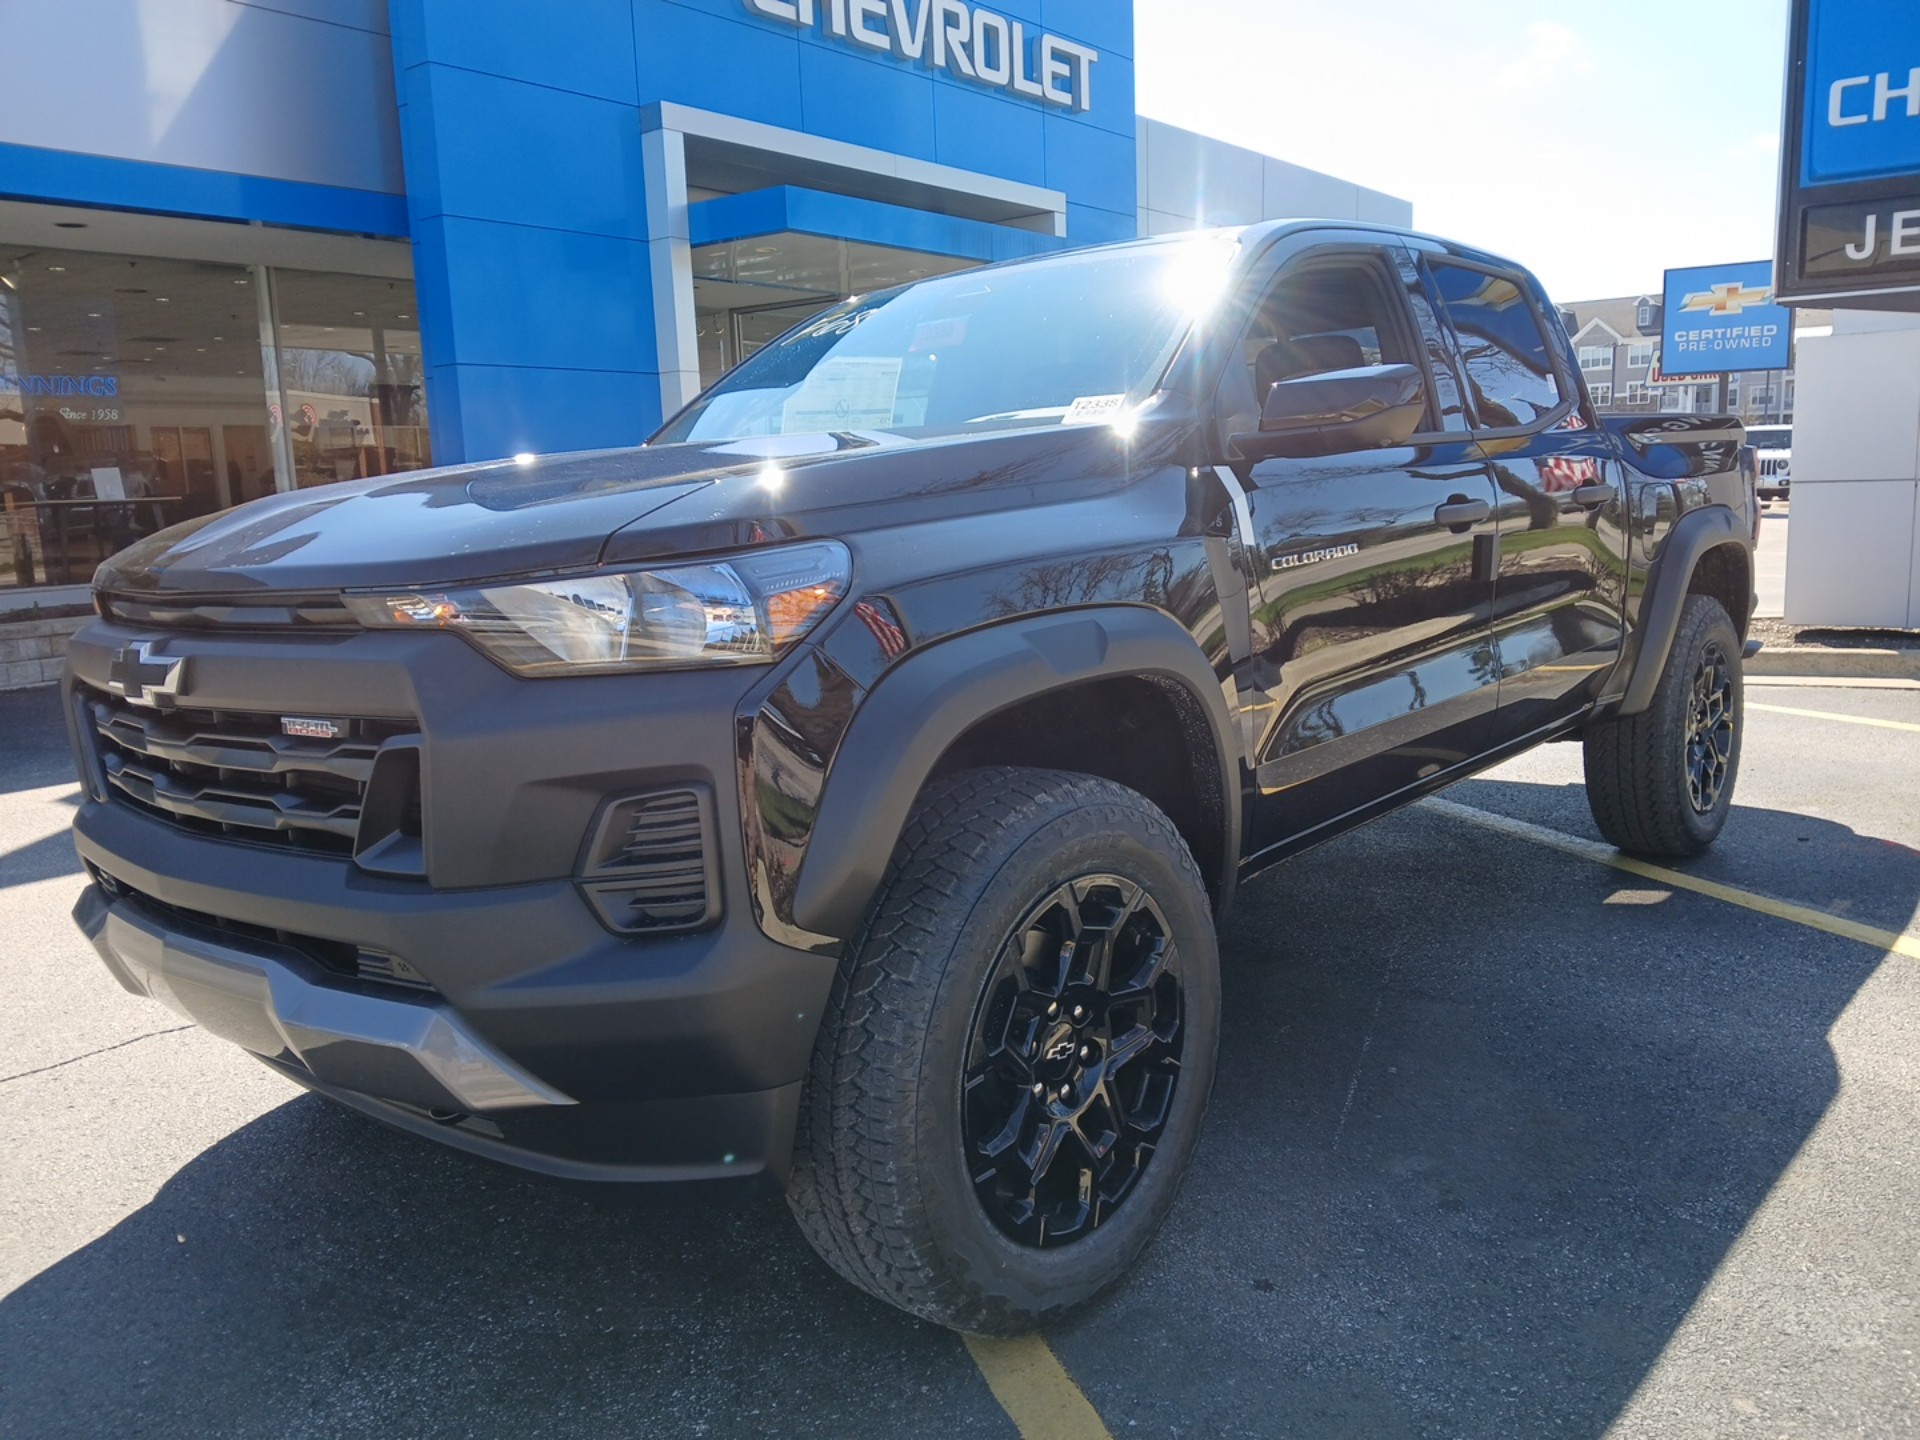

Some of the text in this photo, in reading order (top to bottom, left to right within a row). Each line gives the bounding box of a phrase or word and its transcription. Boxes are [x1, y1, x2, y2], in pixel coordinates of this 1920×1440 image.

[1674, 324, 1778, 342] CERTIFIED
[1678, 336, 1772, 353] PRE-OWNED
[60, 407, 119, 420] Since 1958
[1271, 543, 1360, 570] COLORADO
